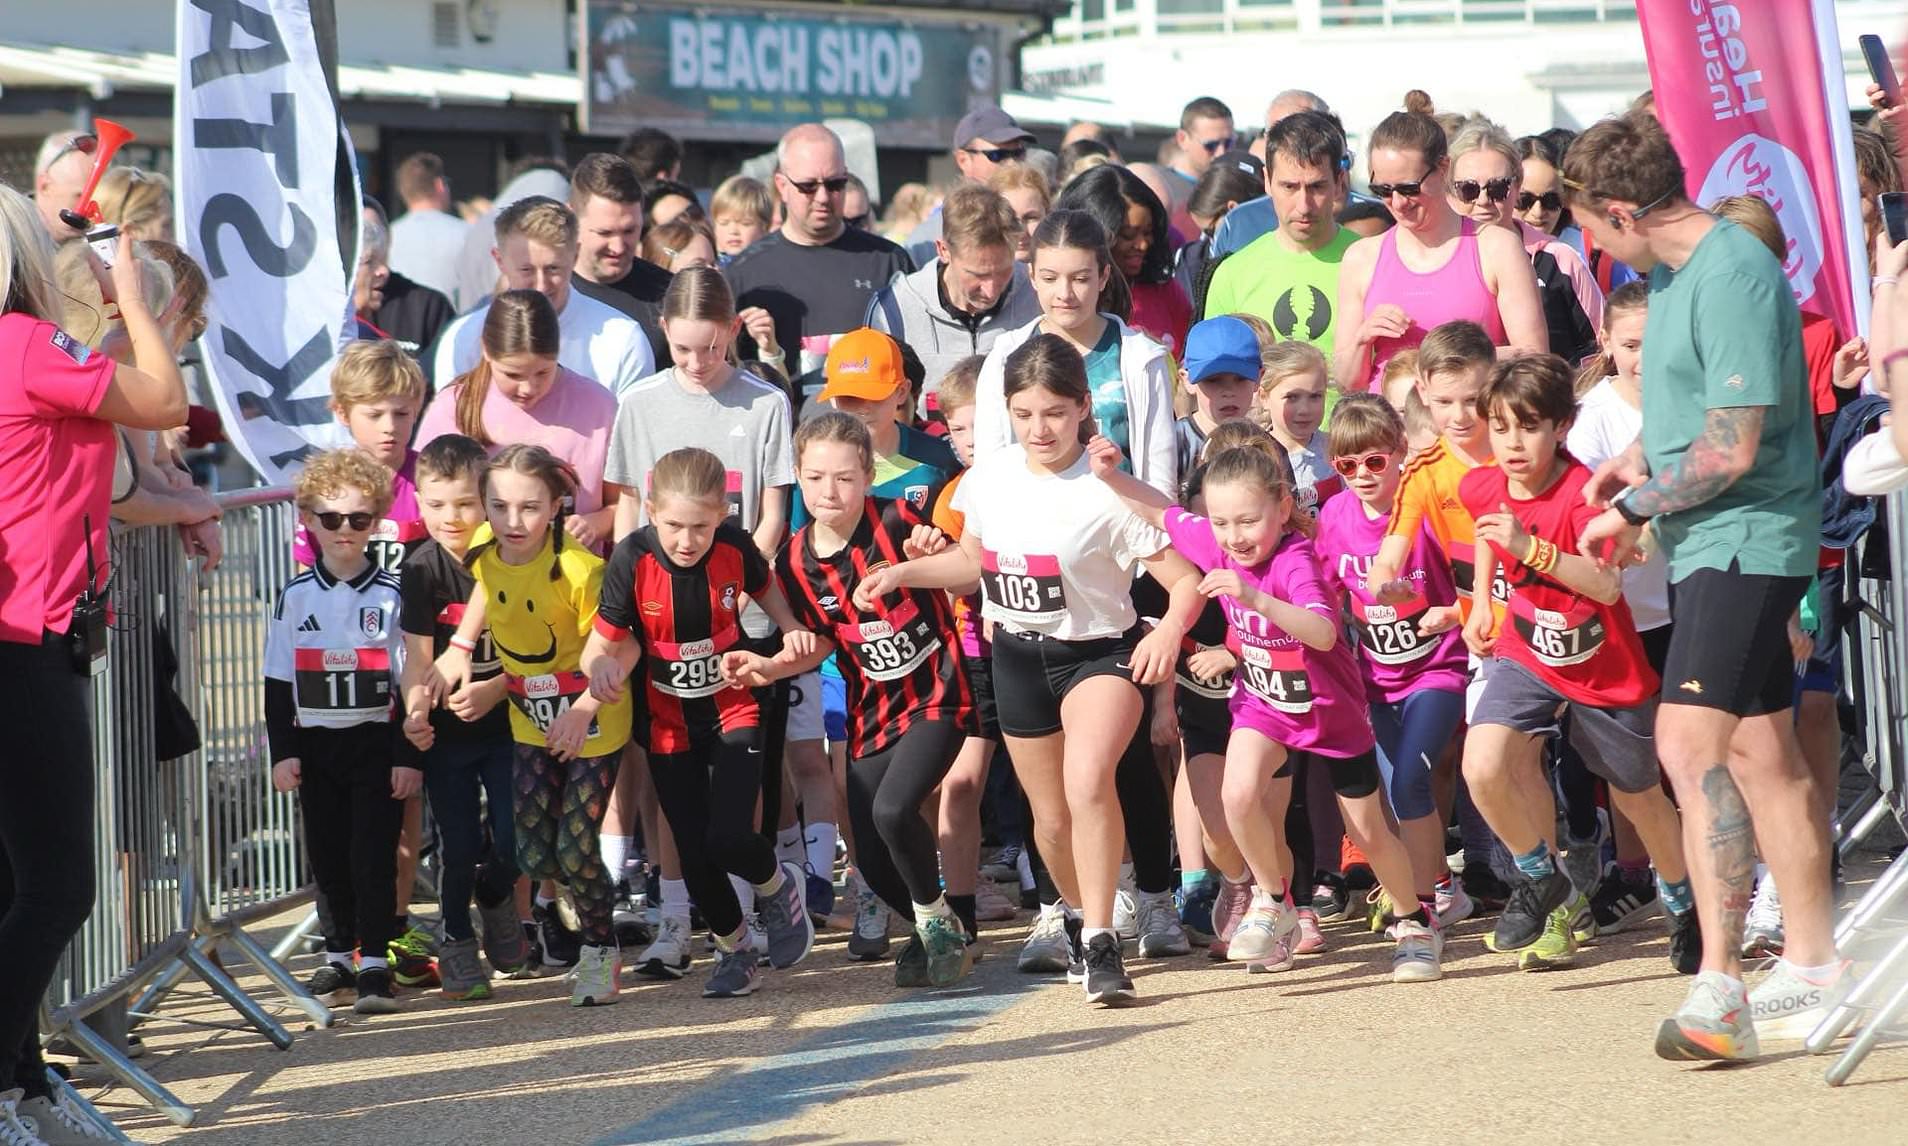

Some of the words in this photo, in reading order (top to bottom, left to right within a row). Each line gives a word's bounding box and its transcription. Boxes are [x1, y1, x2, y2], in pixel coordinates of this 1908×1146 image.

[669, 18, 808, 93] BEACH
[816, 28, 923, 97] SHOP
[363, 541, 406, 575] 12
[1338, 552, 1378, 579] ru
[994, 573, 1041, 612] 103
[863, 624, 894, 638] Vitality
[1223, 593, 1268, 638] un
[680, 644, 713, 658] Vitality
[860, 631, 917, 671] 393
[1366, 620, 1417, 654] 126
[1531, 624, 1580, 657] 467
[324, 651, 358, 667] Vitality
[669, 654, 723, 688] 299
[324, 672, 357, 707] 11
[526, 679, 559, 694] Vitality
[1243, 660, 1289, 701] 194
[1752, 989, 1822, 1015] ROOKS
